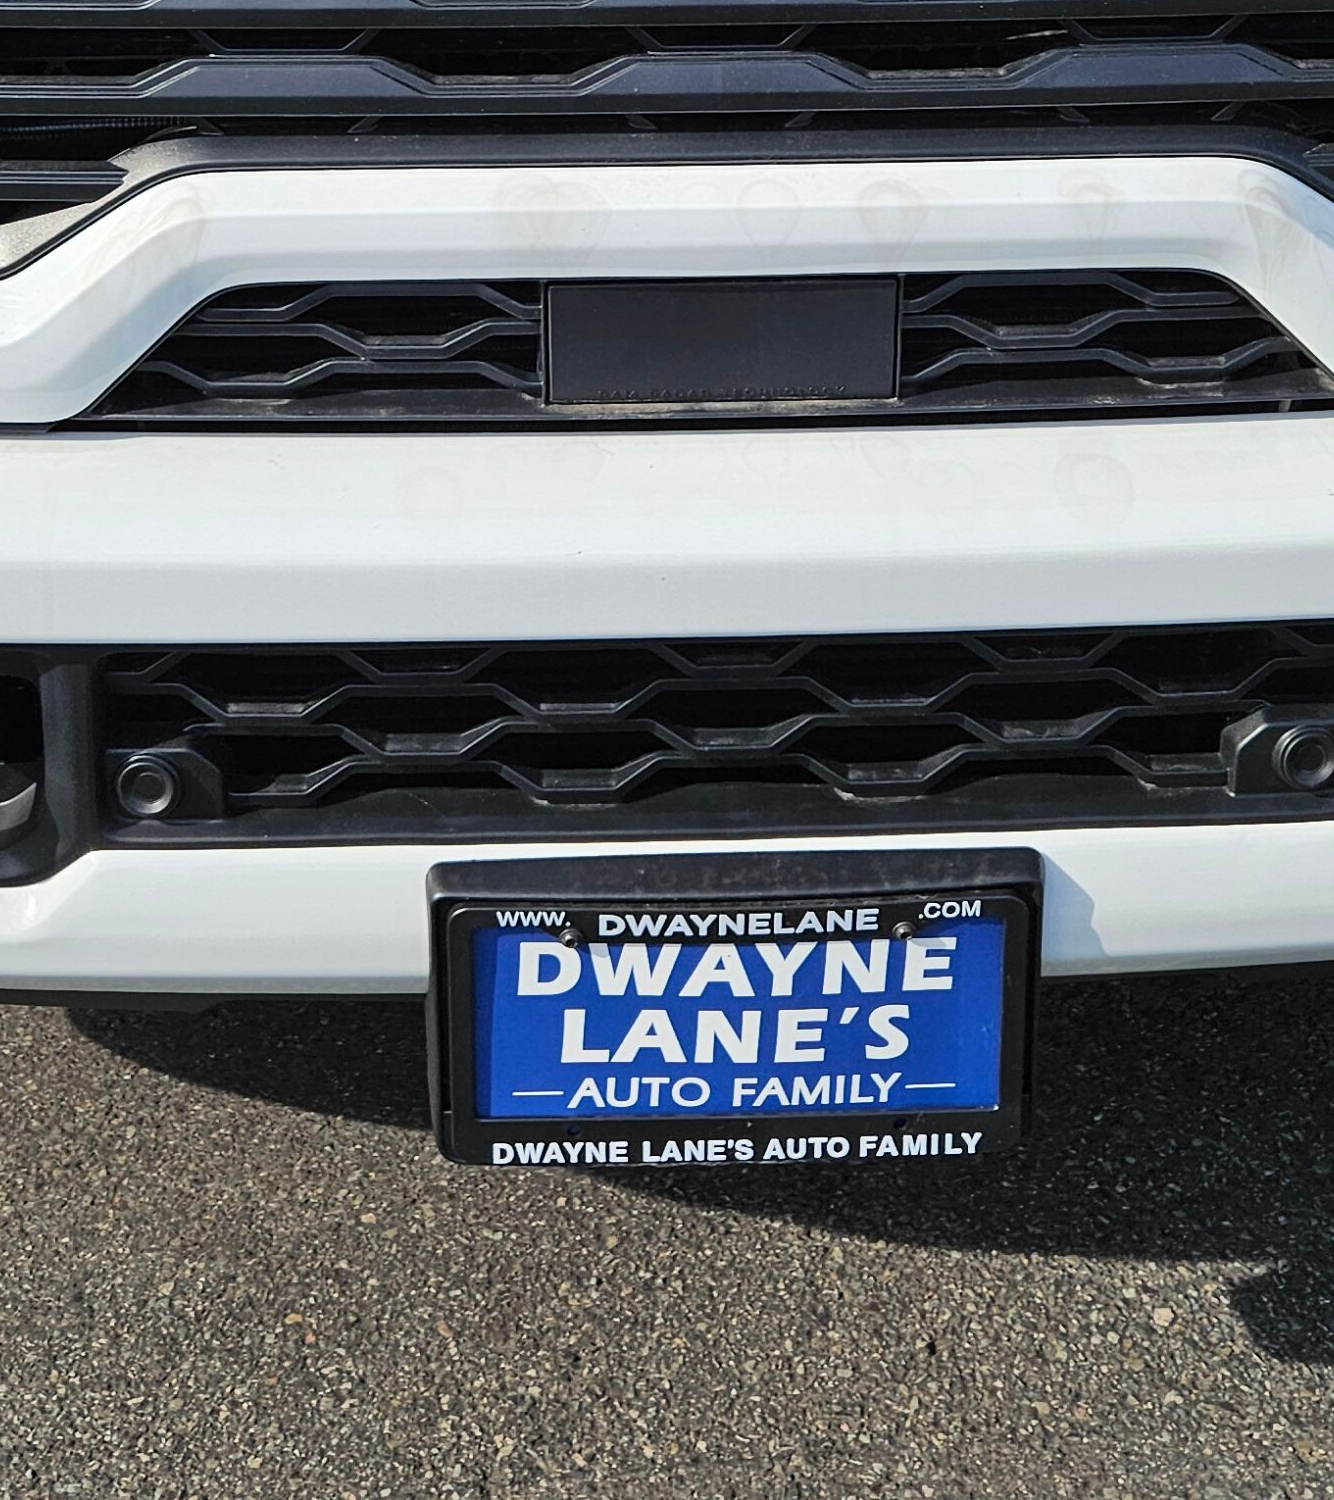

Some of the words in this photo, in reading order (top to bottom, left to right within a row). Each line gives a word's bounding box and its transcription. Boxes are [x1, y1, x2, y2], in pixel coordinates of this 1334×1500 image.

[598, 908, 879, 937] DWAYNELANE
[918, 900, 981, 919] .COM
[517, 936, 957, 997] DWAYNE
[561, 1004, 910, 1063] LANE'S
[567, 1077, 711, 1108] AUTO
[732, 1072, 902, 1107] FAMILY
[492, 1140, 629, 1165] DWAYNE
[642, 1138, 754, 1162] LANE'S
[763, 1137, 850, 1160] AUTO
[859, 1132, 982, 1157] FAMILY
